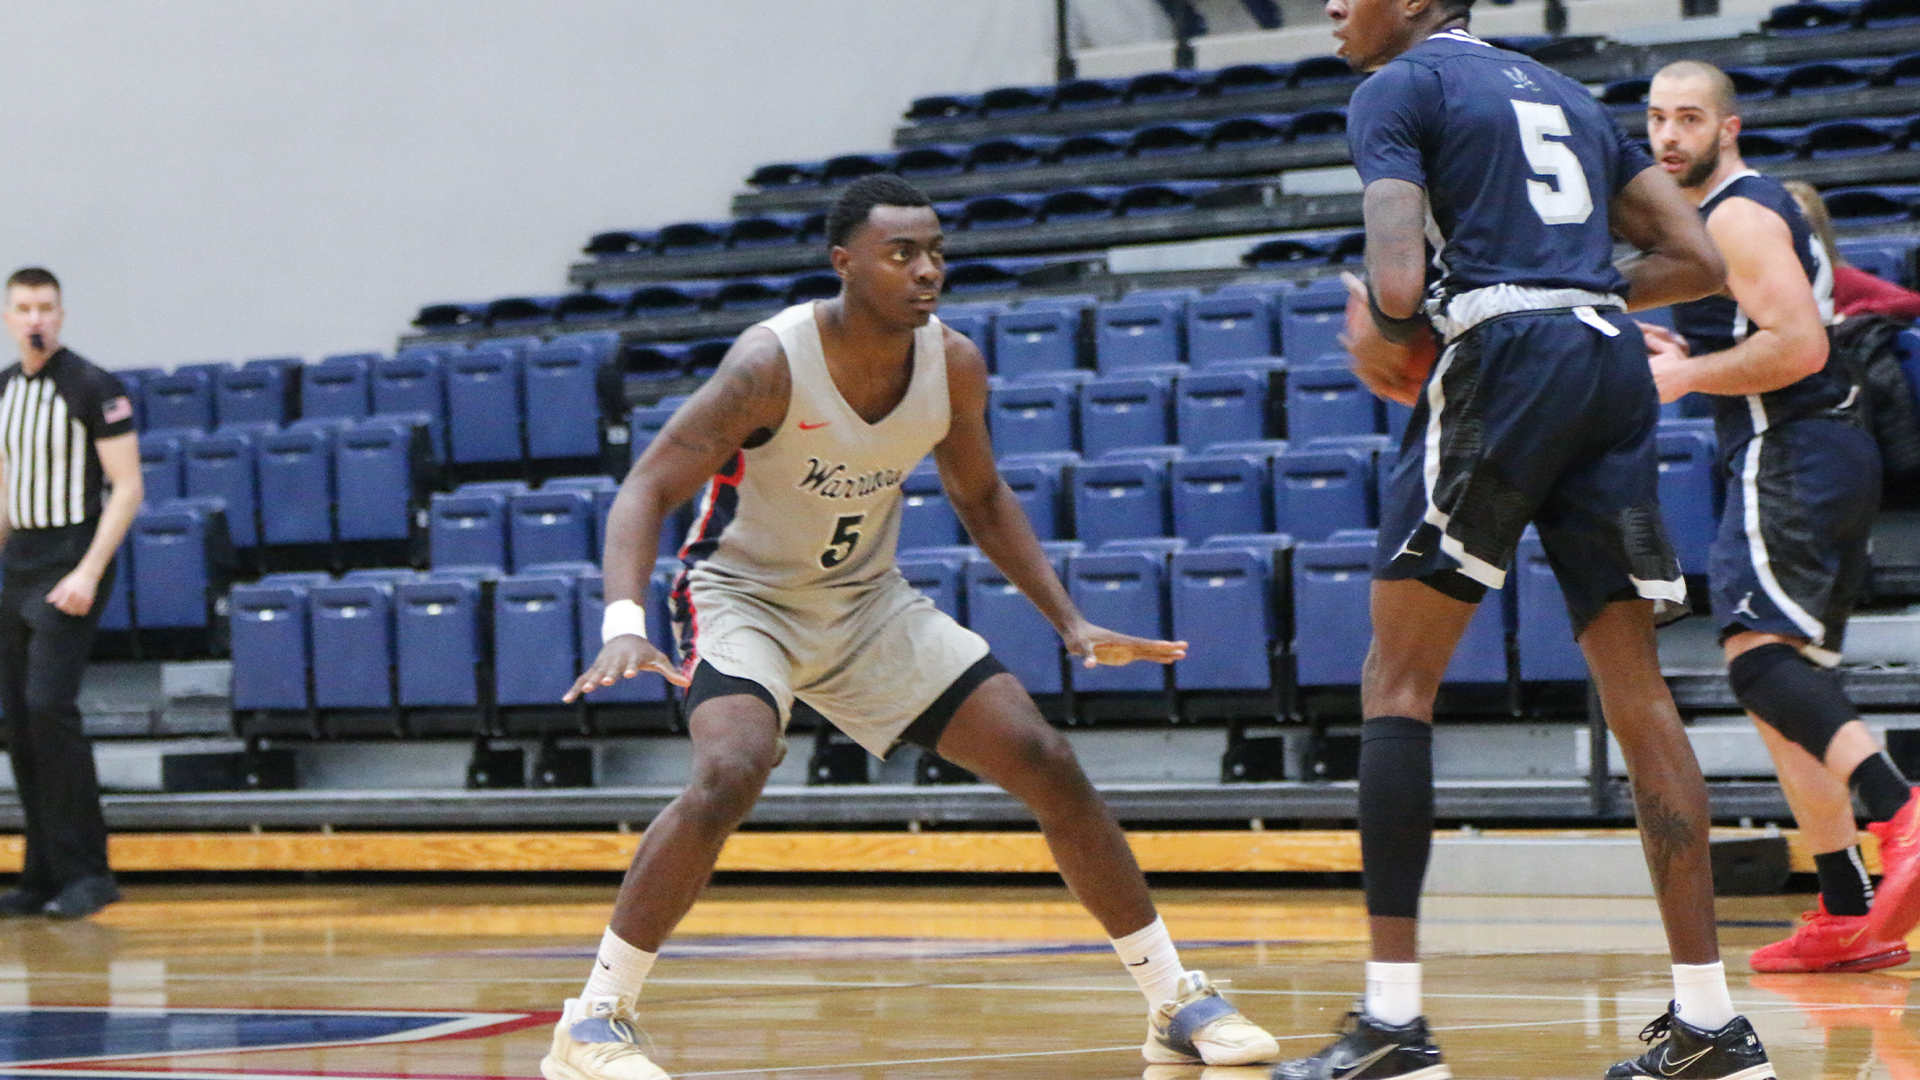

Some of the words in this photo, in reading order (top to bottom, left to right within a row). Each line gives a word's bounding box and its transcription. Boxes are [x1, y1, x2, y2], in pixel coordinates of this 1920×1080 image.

[1510, 99, 1594, 225] 5
[797, 457, 904, 499] Warrior
[819, 513, 865, 569] 5
